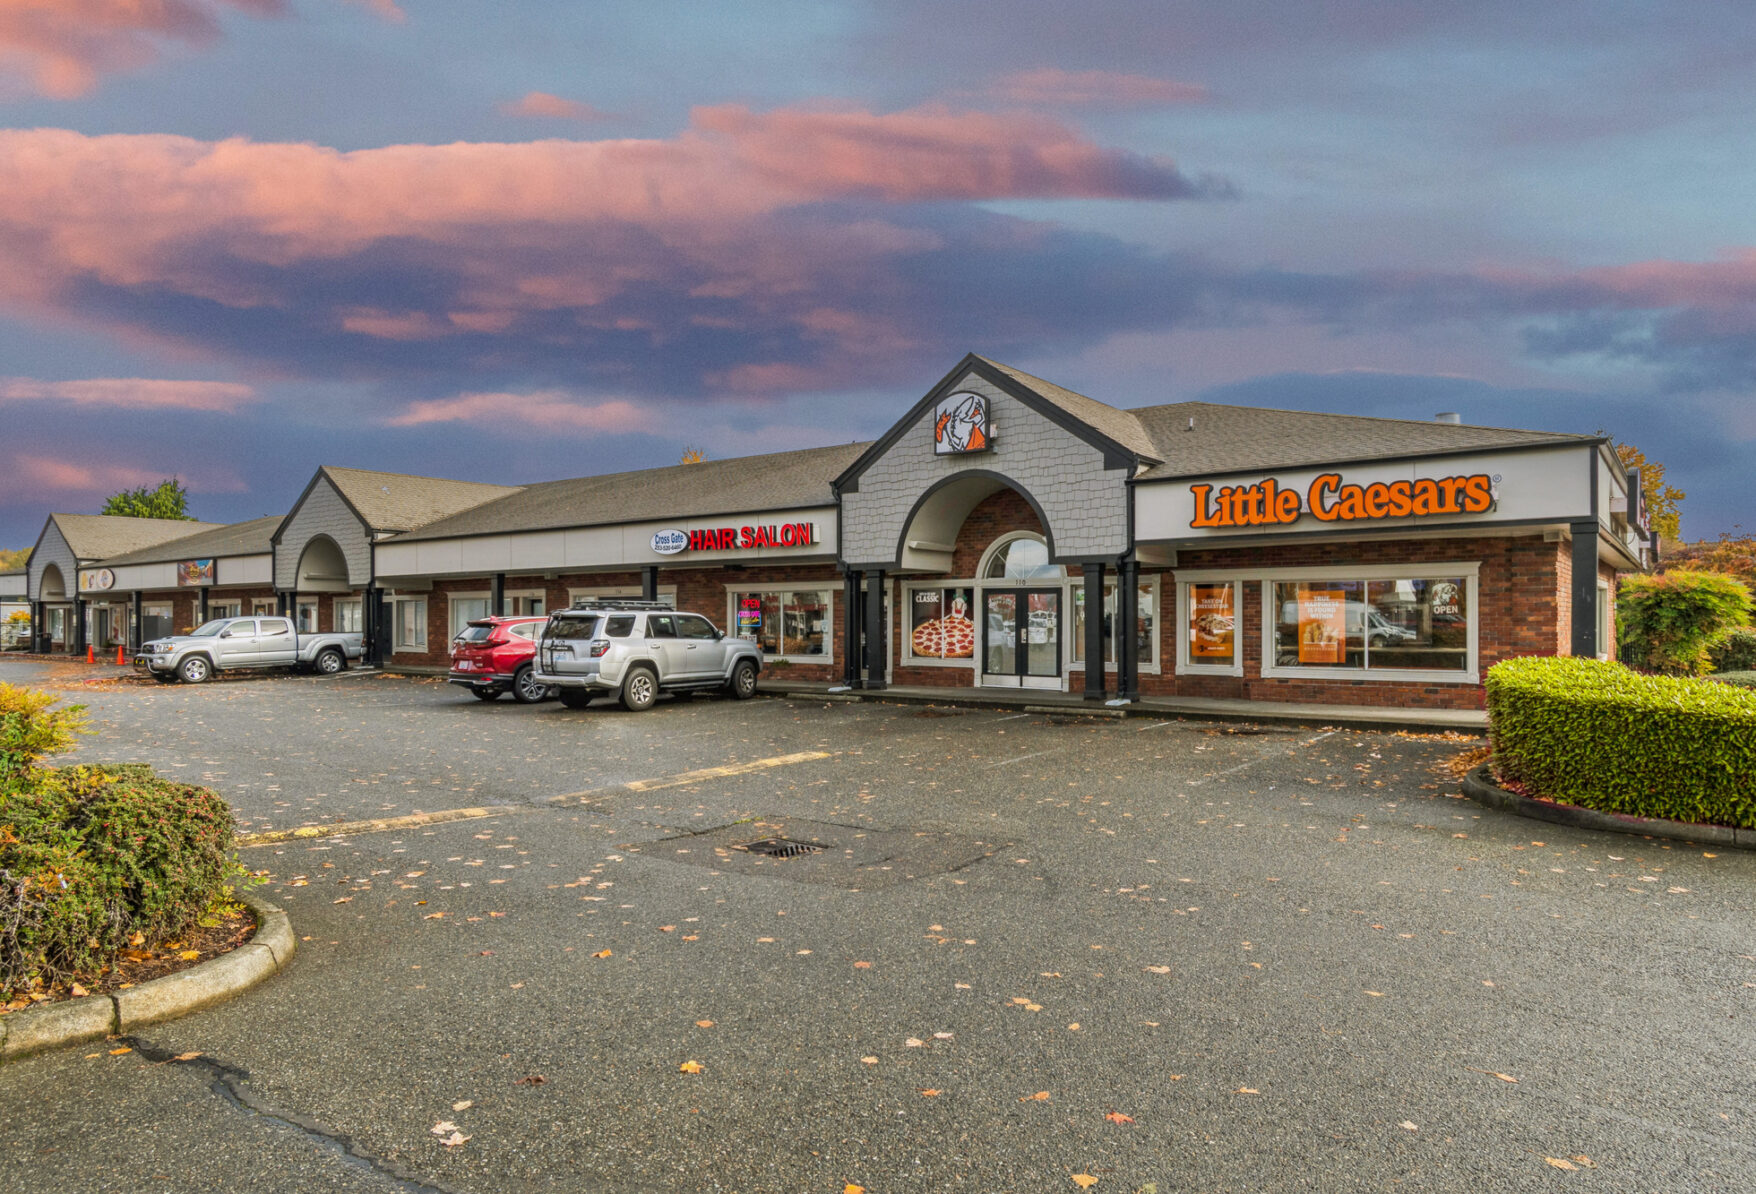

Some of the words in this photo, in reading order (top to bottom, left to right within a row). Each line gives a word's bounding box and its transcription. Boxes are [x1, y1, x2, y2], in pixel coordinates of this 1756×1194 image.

[1190, 478, 1300, 528] Little
[1308, 473, 1492, 521] Caesars
[655, 534, 670, 544] Cross
[671, 533, 684, 543] Gate
[690, 528, 735, 550] HAIR
[741, 522, 810, 548] SALON
[742, 598, 760, 608] OPEN
[916, 594, 940, 602] CLASSIC
[1434, 606, 1458, 614] OPEN
